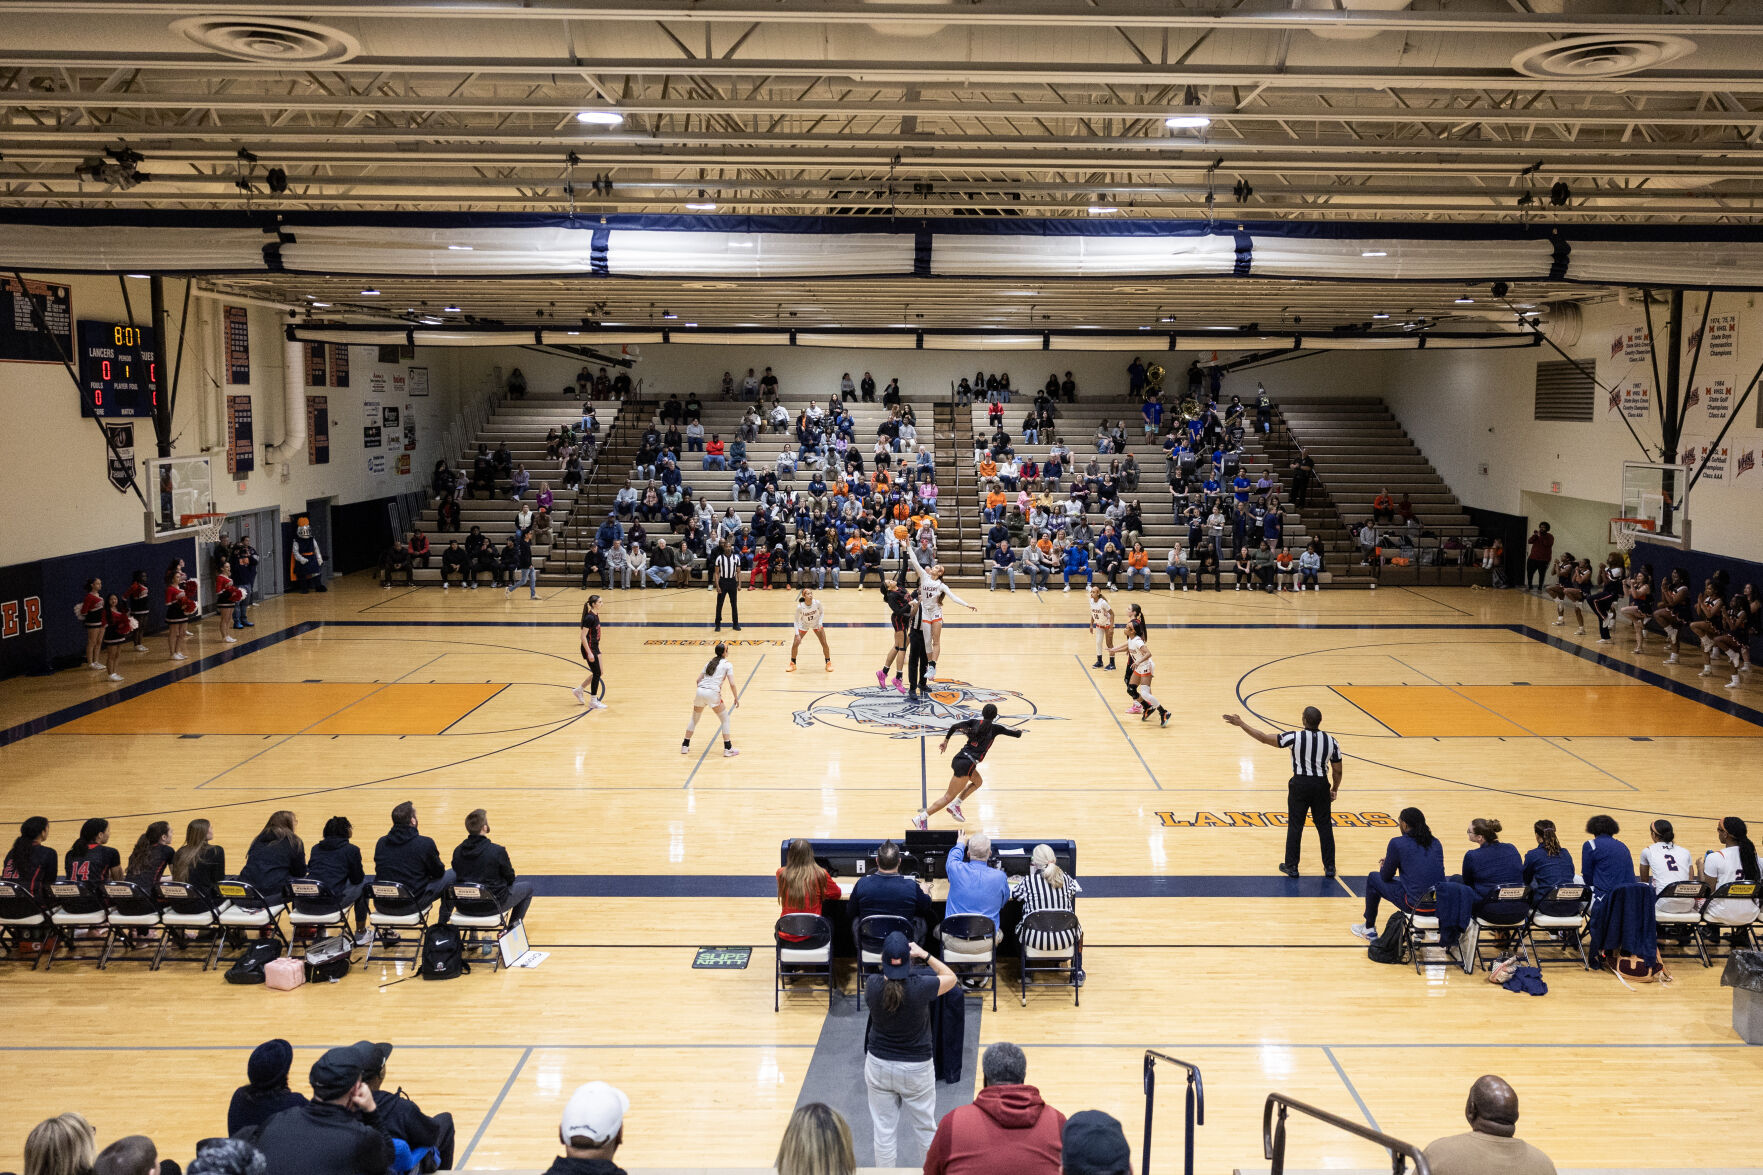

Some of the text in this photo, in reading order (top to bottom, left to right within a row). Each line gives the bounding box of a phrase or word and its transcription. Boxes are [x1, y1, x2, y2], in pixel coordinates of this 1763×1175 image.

[89, 347, 114, 359] LANCERS
[102, 361, 111, 380] 0
[125, 365, 130, 378] 1
[95, 389, 102, 406] 0
[72, 860, 91, 881] 14
[1664, 854, 1679, 872] 2
